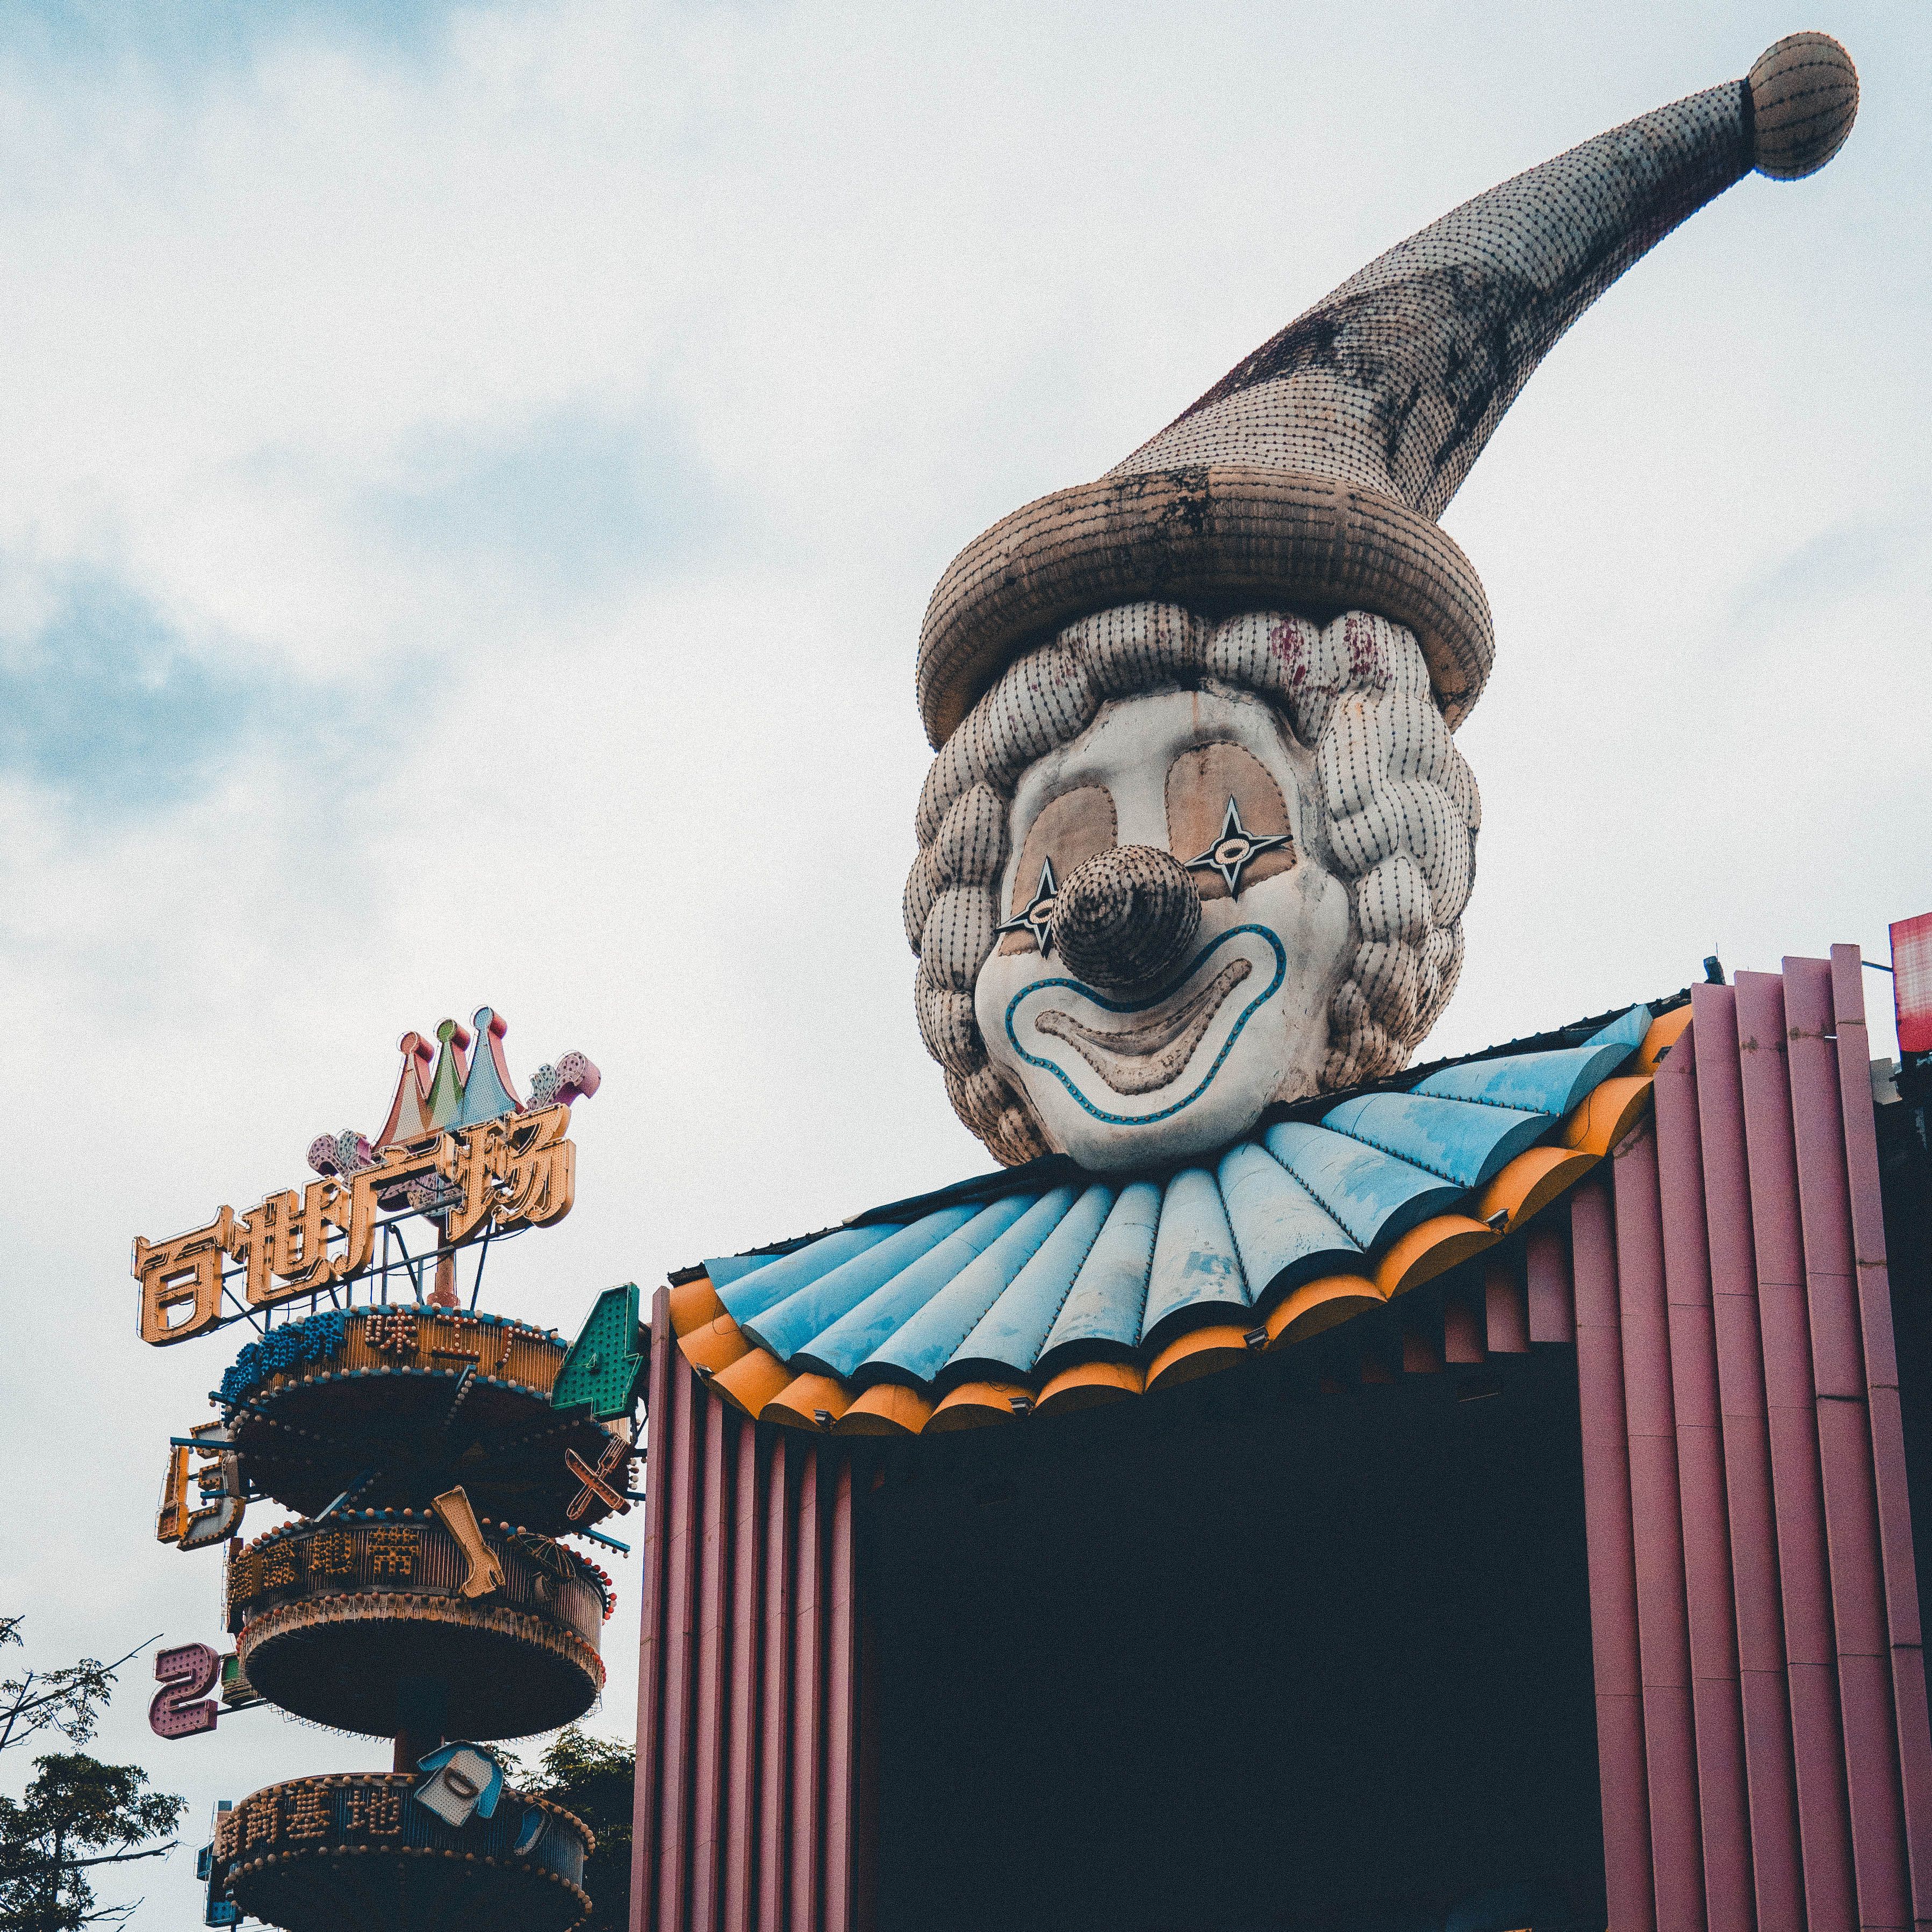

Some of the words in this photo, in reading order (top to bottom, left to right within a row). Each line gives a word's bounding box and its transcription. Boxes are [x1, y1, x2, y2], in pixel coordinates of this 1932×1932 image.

[133, 1103, 576, 1347] 百世广场
[550, 1282, 643, 1419] 4
[149, 1642, 218, 1740] 2
